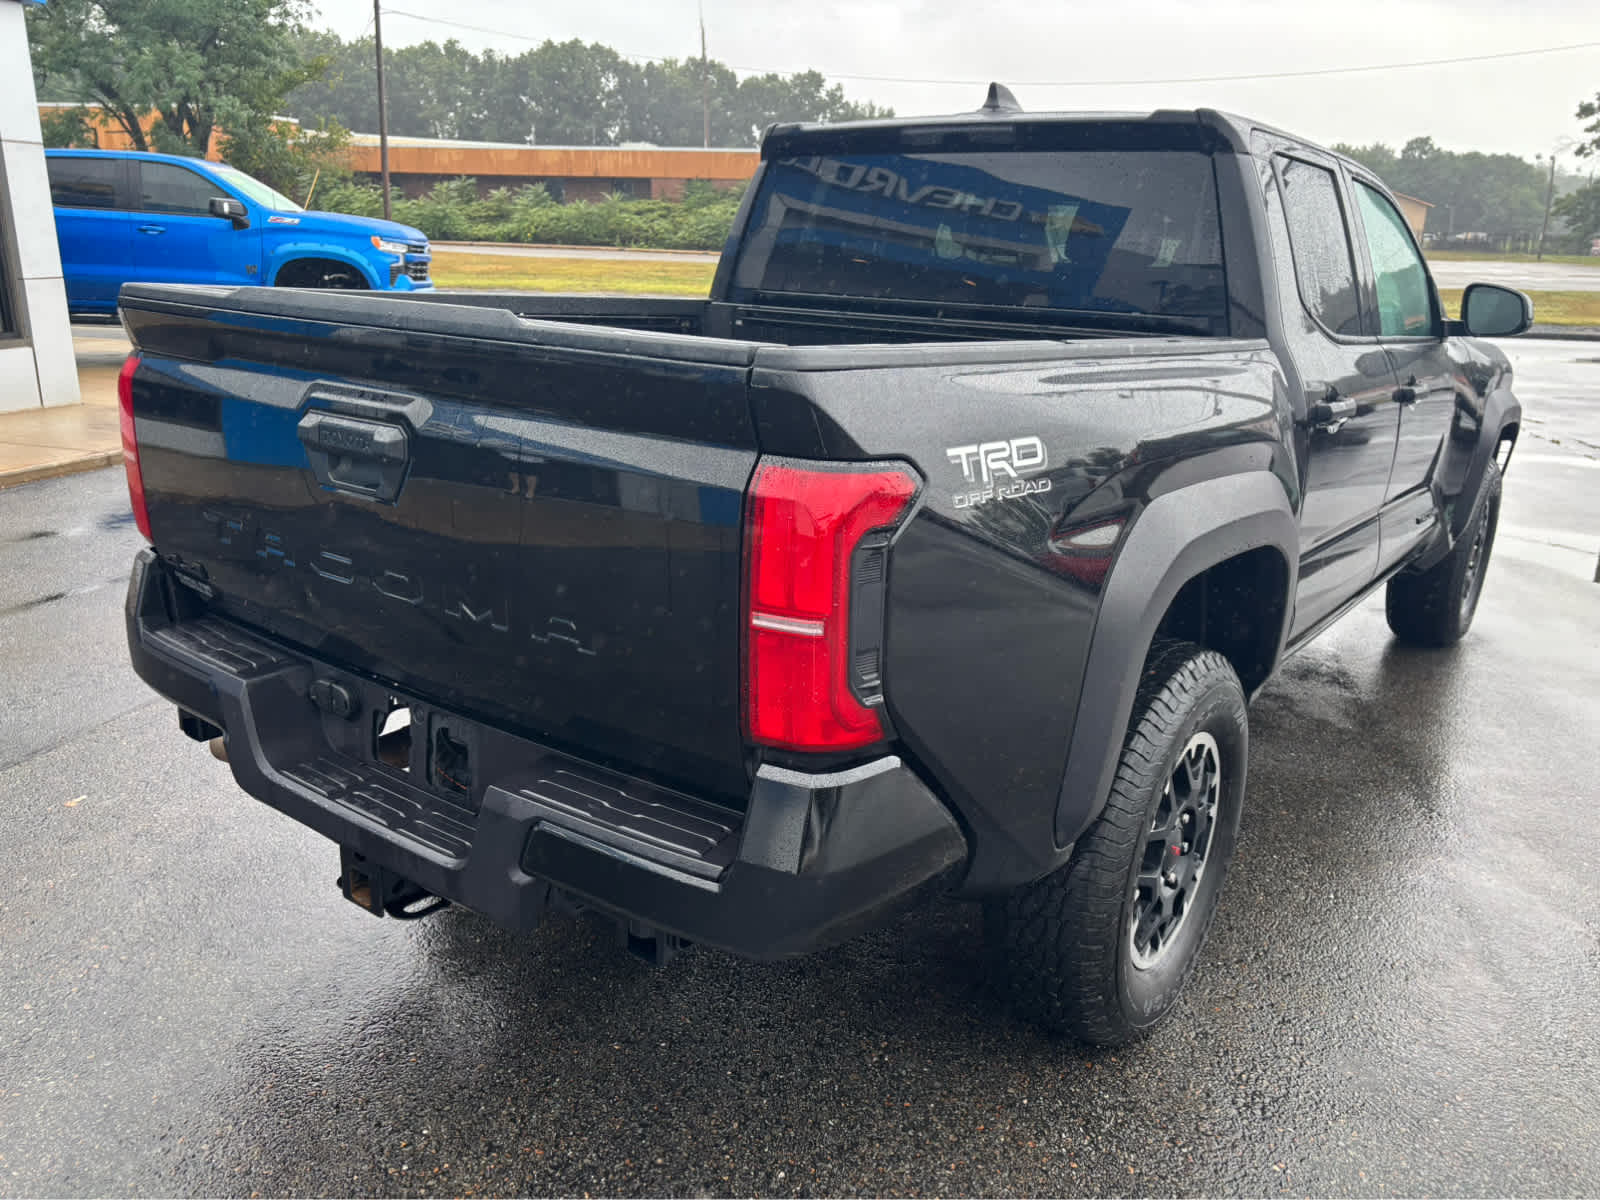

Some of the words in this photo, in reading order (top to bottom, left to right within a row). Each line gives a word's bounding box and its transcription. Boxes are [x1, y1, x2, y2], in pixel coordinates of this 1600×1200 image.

[946, 436, 1047, 486] TRD
[952, 489, 994, 508] OFF
[997, 478, 1052, 501] ROAD
